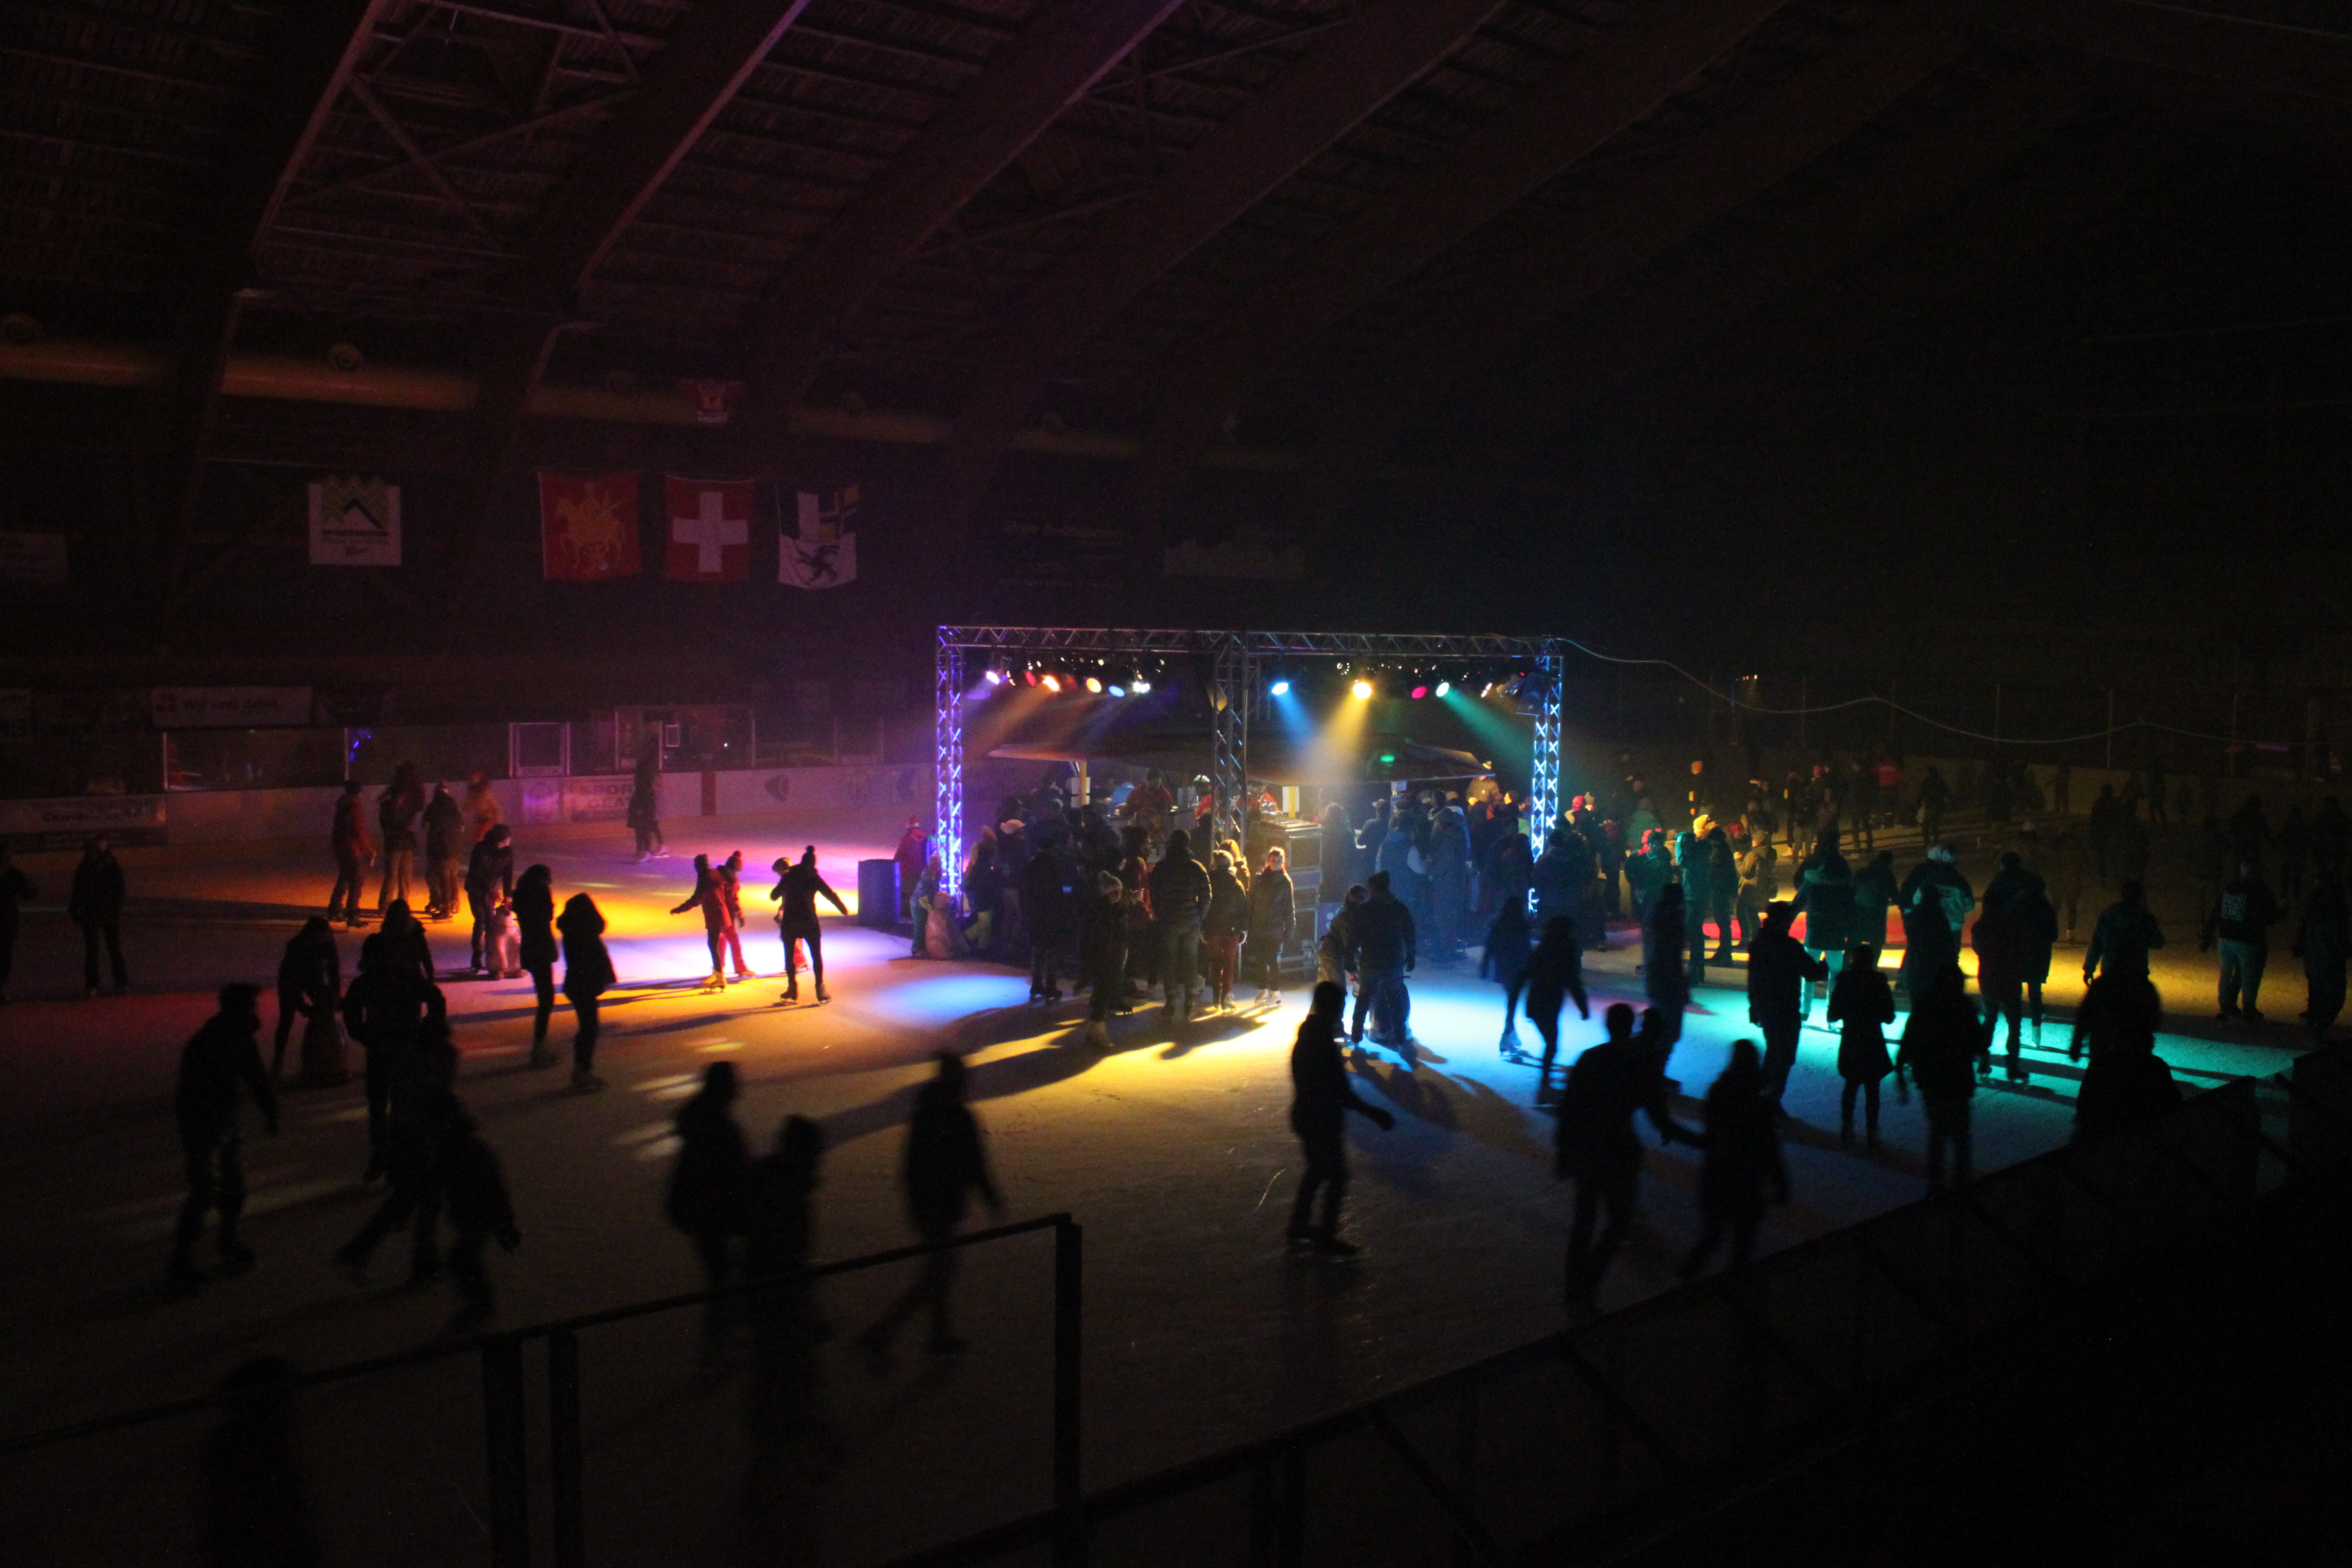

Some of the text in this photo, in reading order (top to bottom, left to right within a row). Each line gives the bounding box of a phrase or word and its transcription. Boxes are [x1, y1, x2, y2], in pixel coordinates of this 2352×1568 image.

[180, 697, 207, 711] Wir
[210, 697, 238, 710] sind
[580, 783, 634, 795] SPOR
